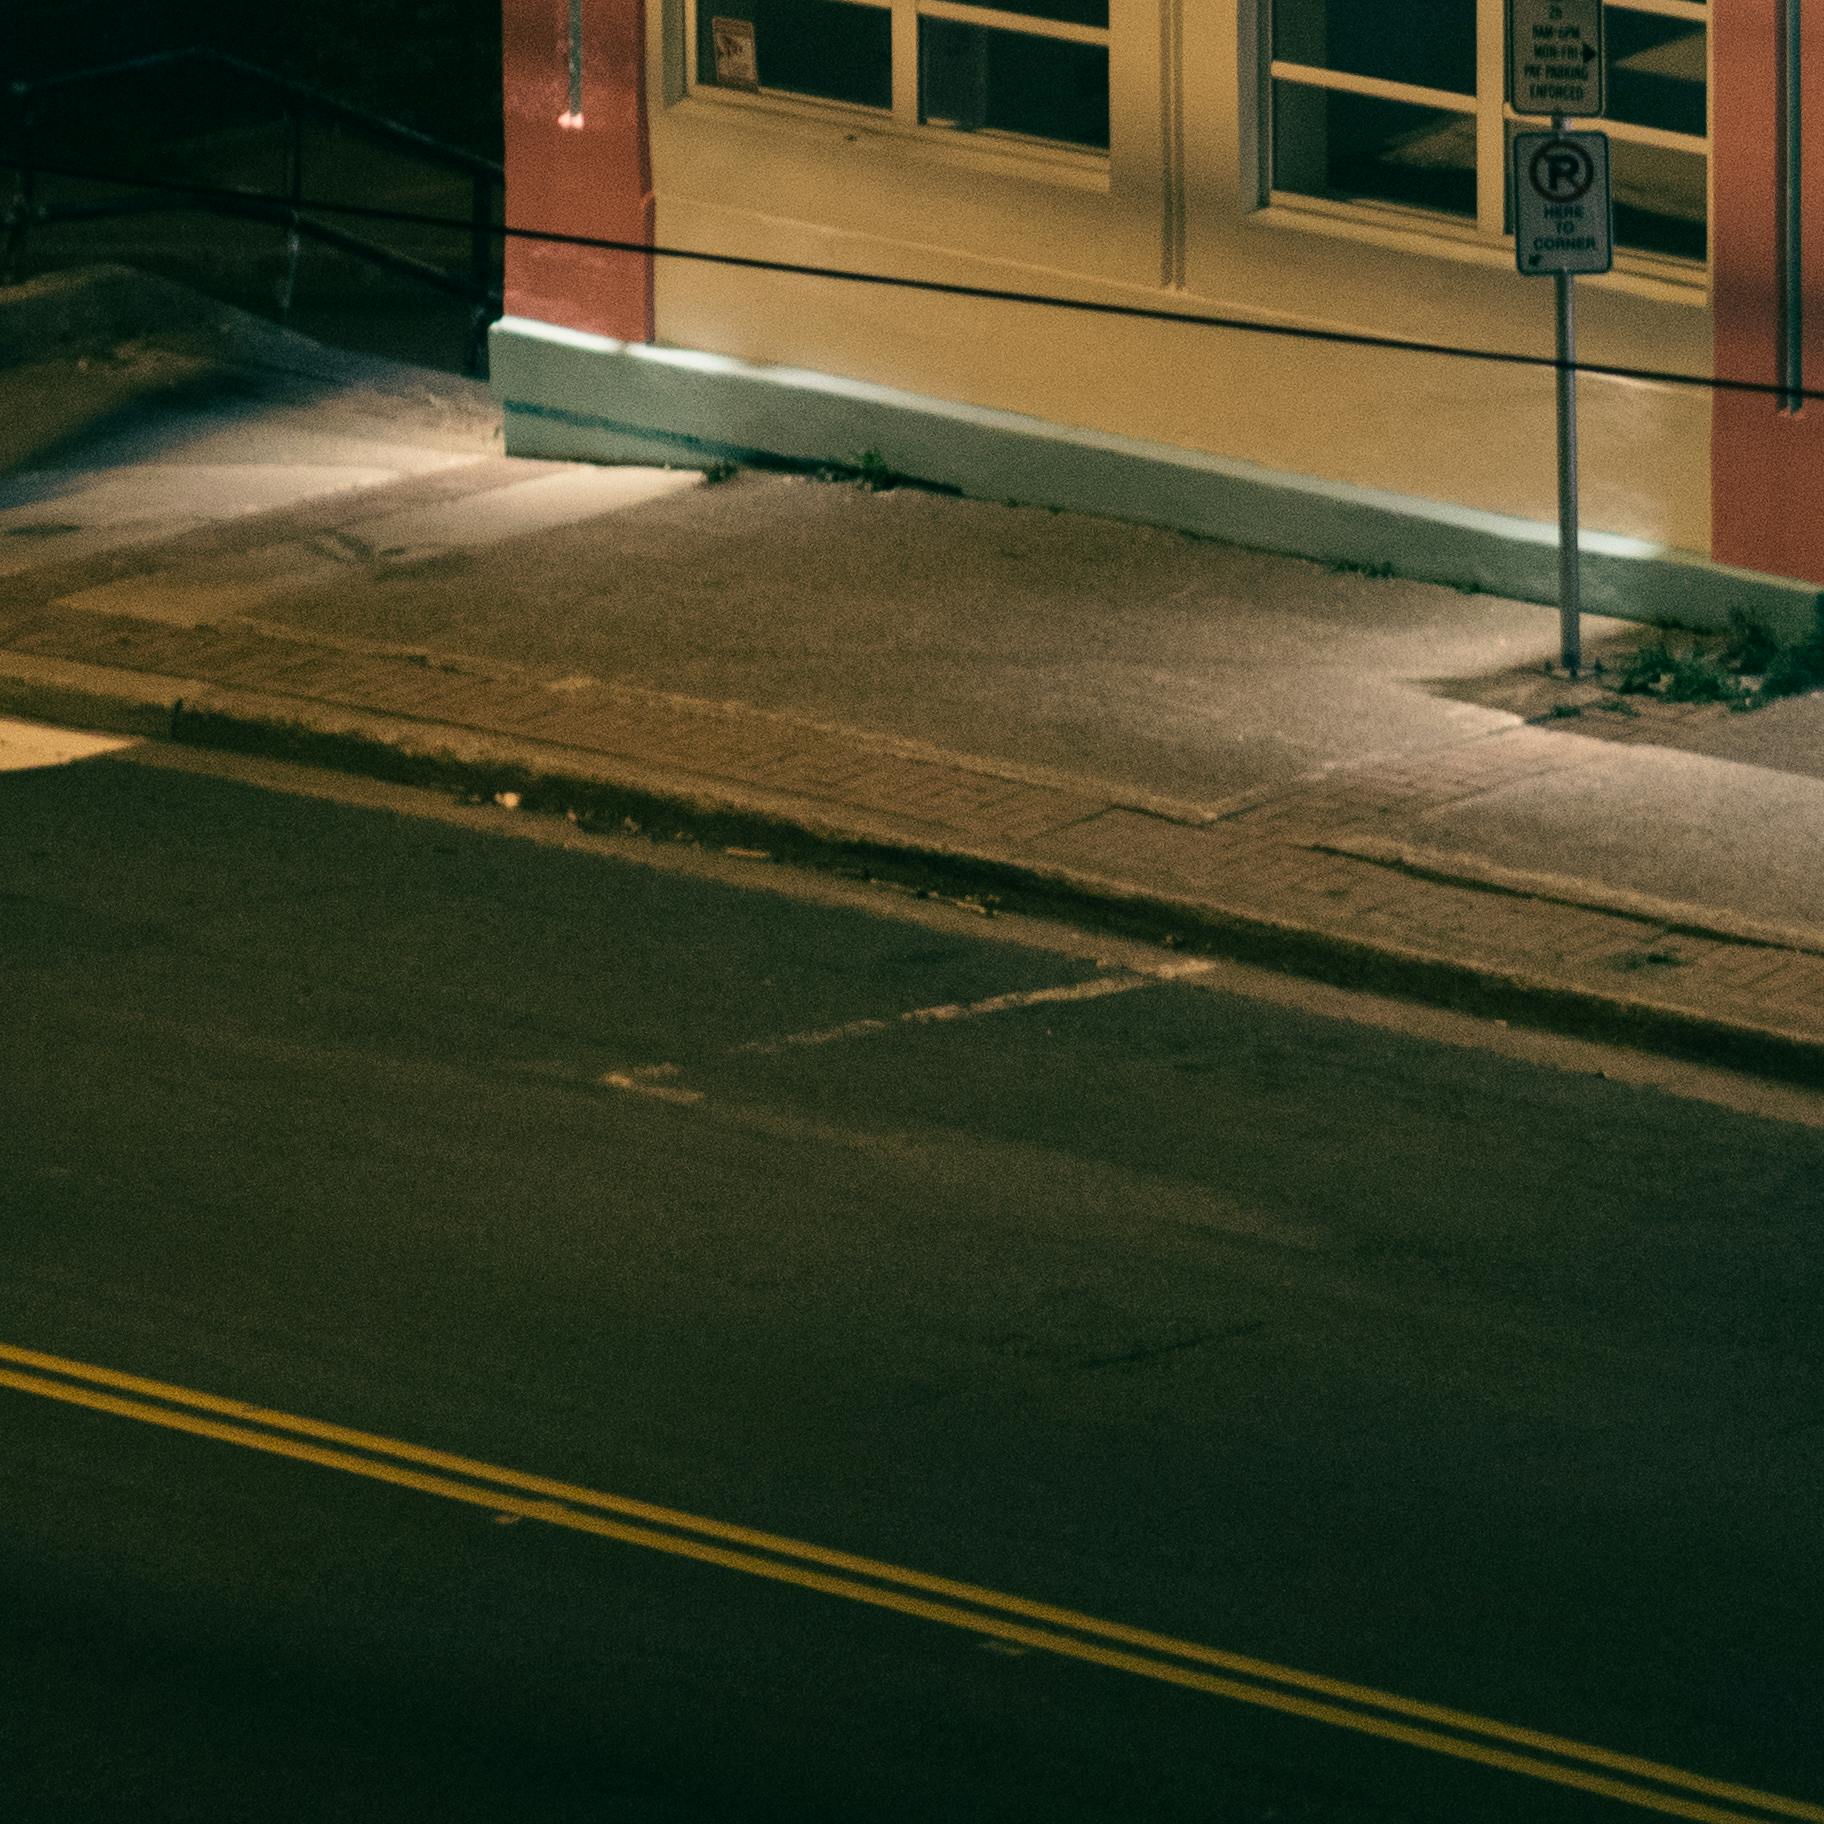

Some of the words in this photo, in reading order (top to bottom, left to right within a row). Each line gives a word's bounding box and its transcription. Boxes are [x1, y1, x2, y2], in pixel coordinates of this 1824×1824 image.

[1543, 203, 1584, 219] HERE
[1554, 220, 1575, 235] TO
[1532, 235, 1597, 251] CORNER
